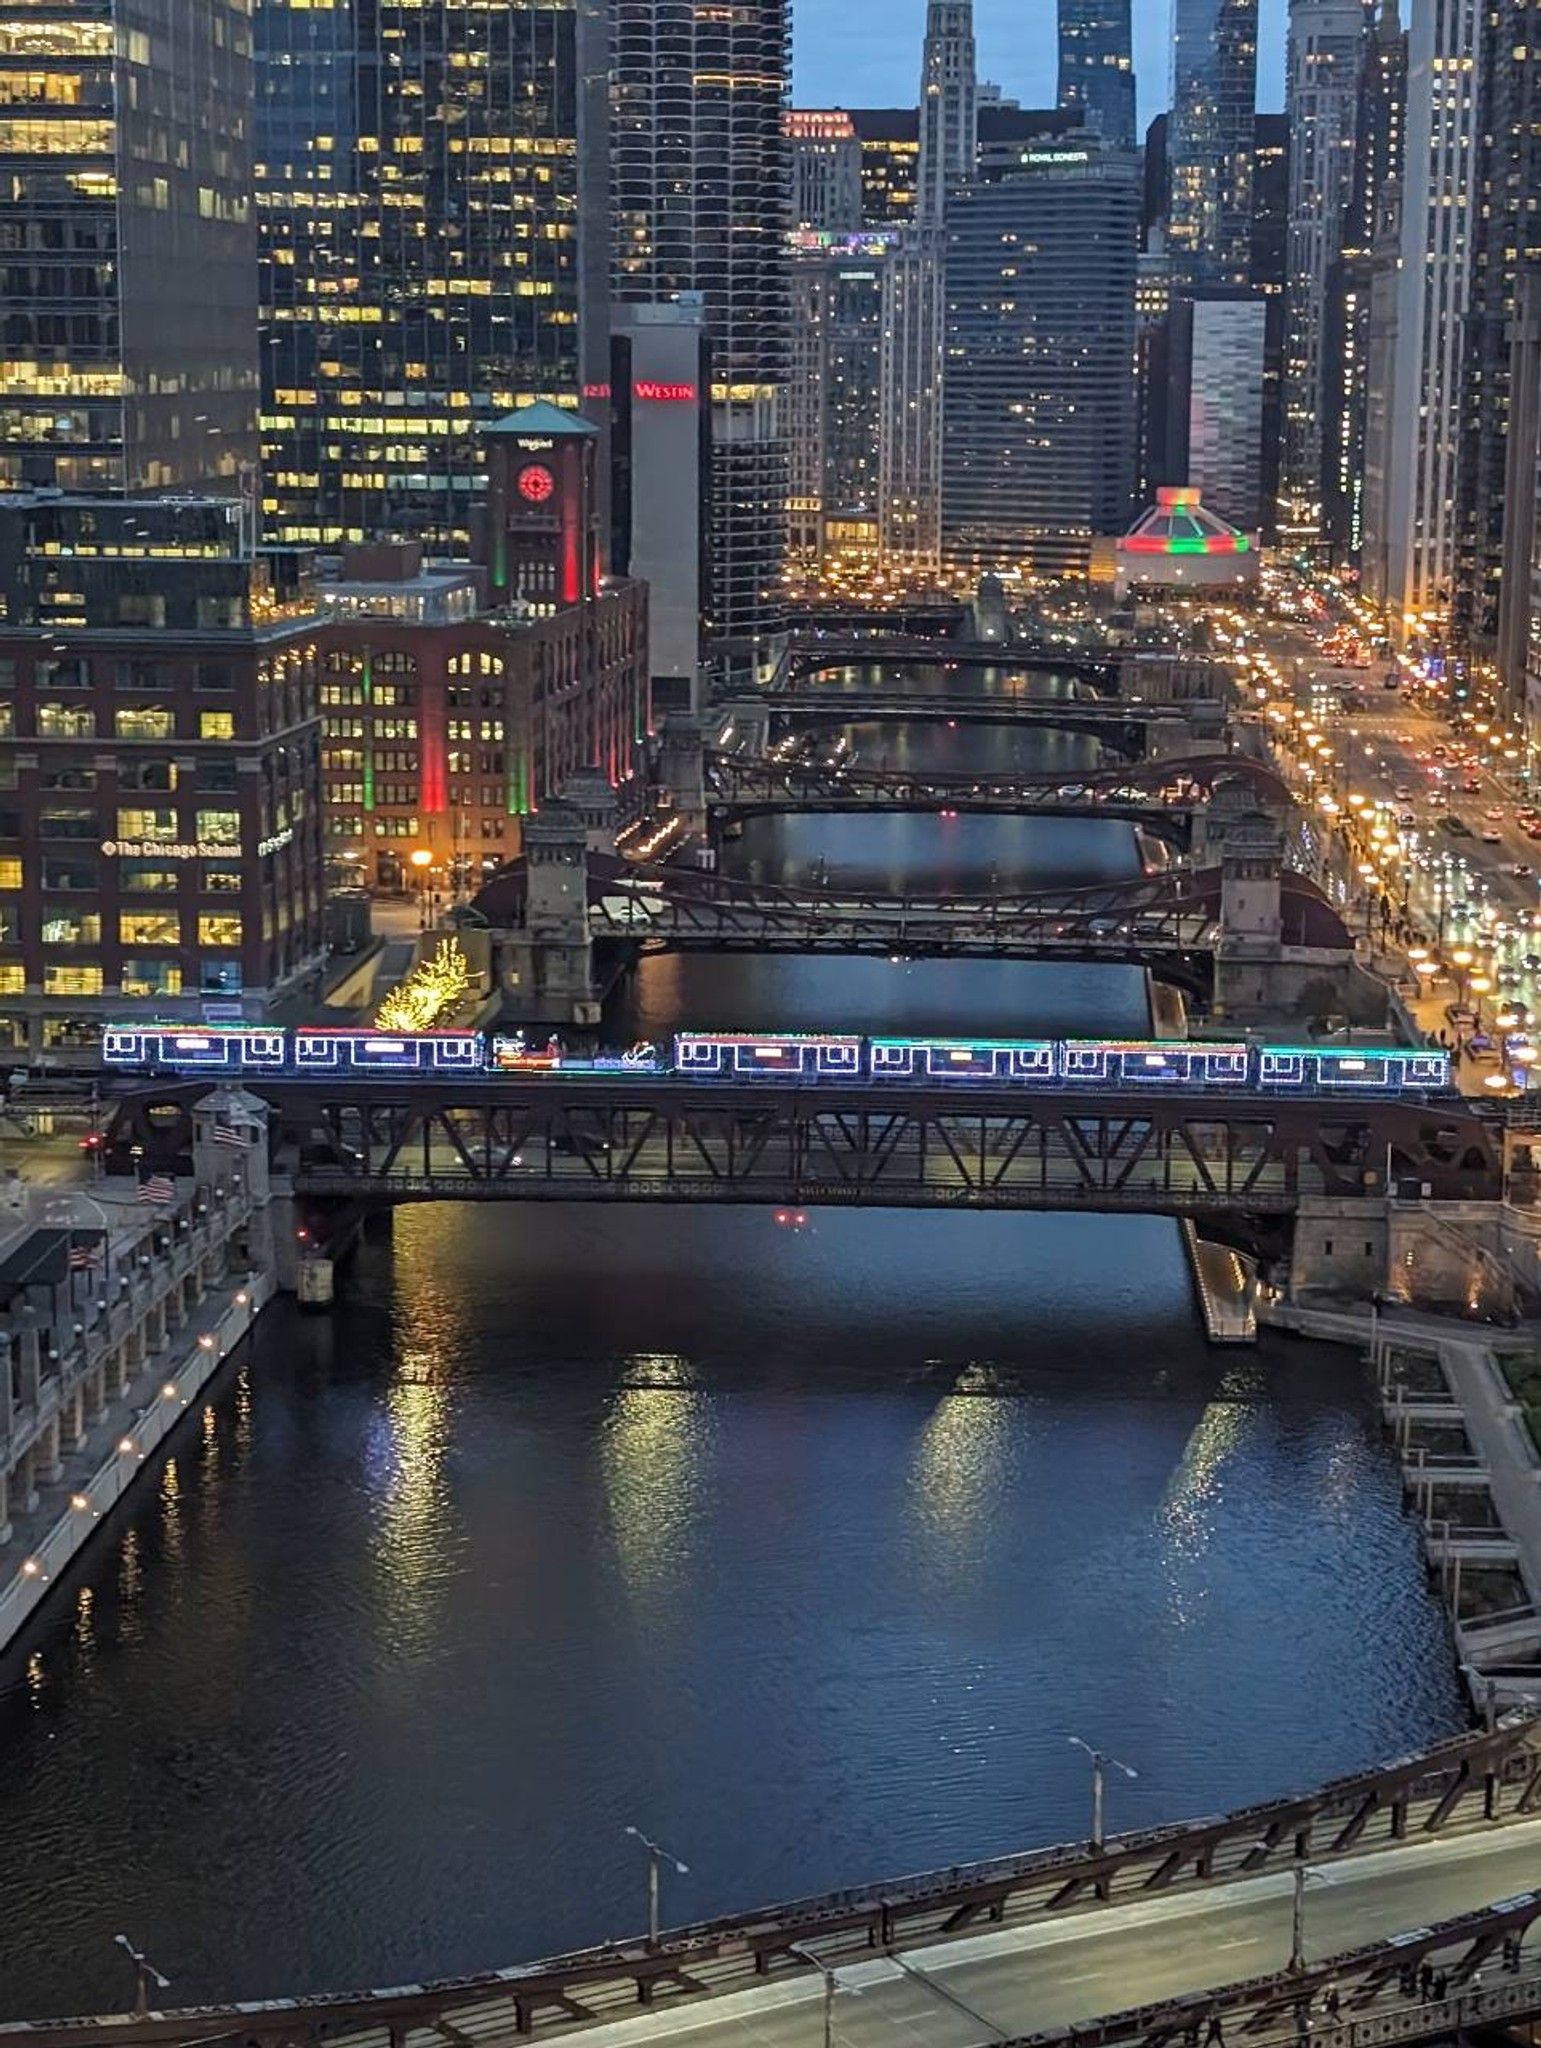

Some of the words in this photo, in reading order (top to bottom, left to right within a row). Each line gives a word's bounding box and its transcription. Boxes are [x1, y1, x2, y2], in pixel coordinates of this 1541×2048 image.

[636, 383, 694, 398] WESTIN
[116, 841, 140, 857] The
[143, 841, 197, 859] Chicago
[199, 841, 242, 857] School
